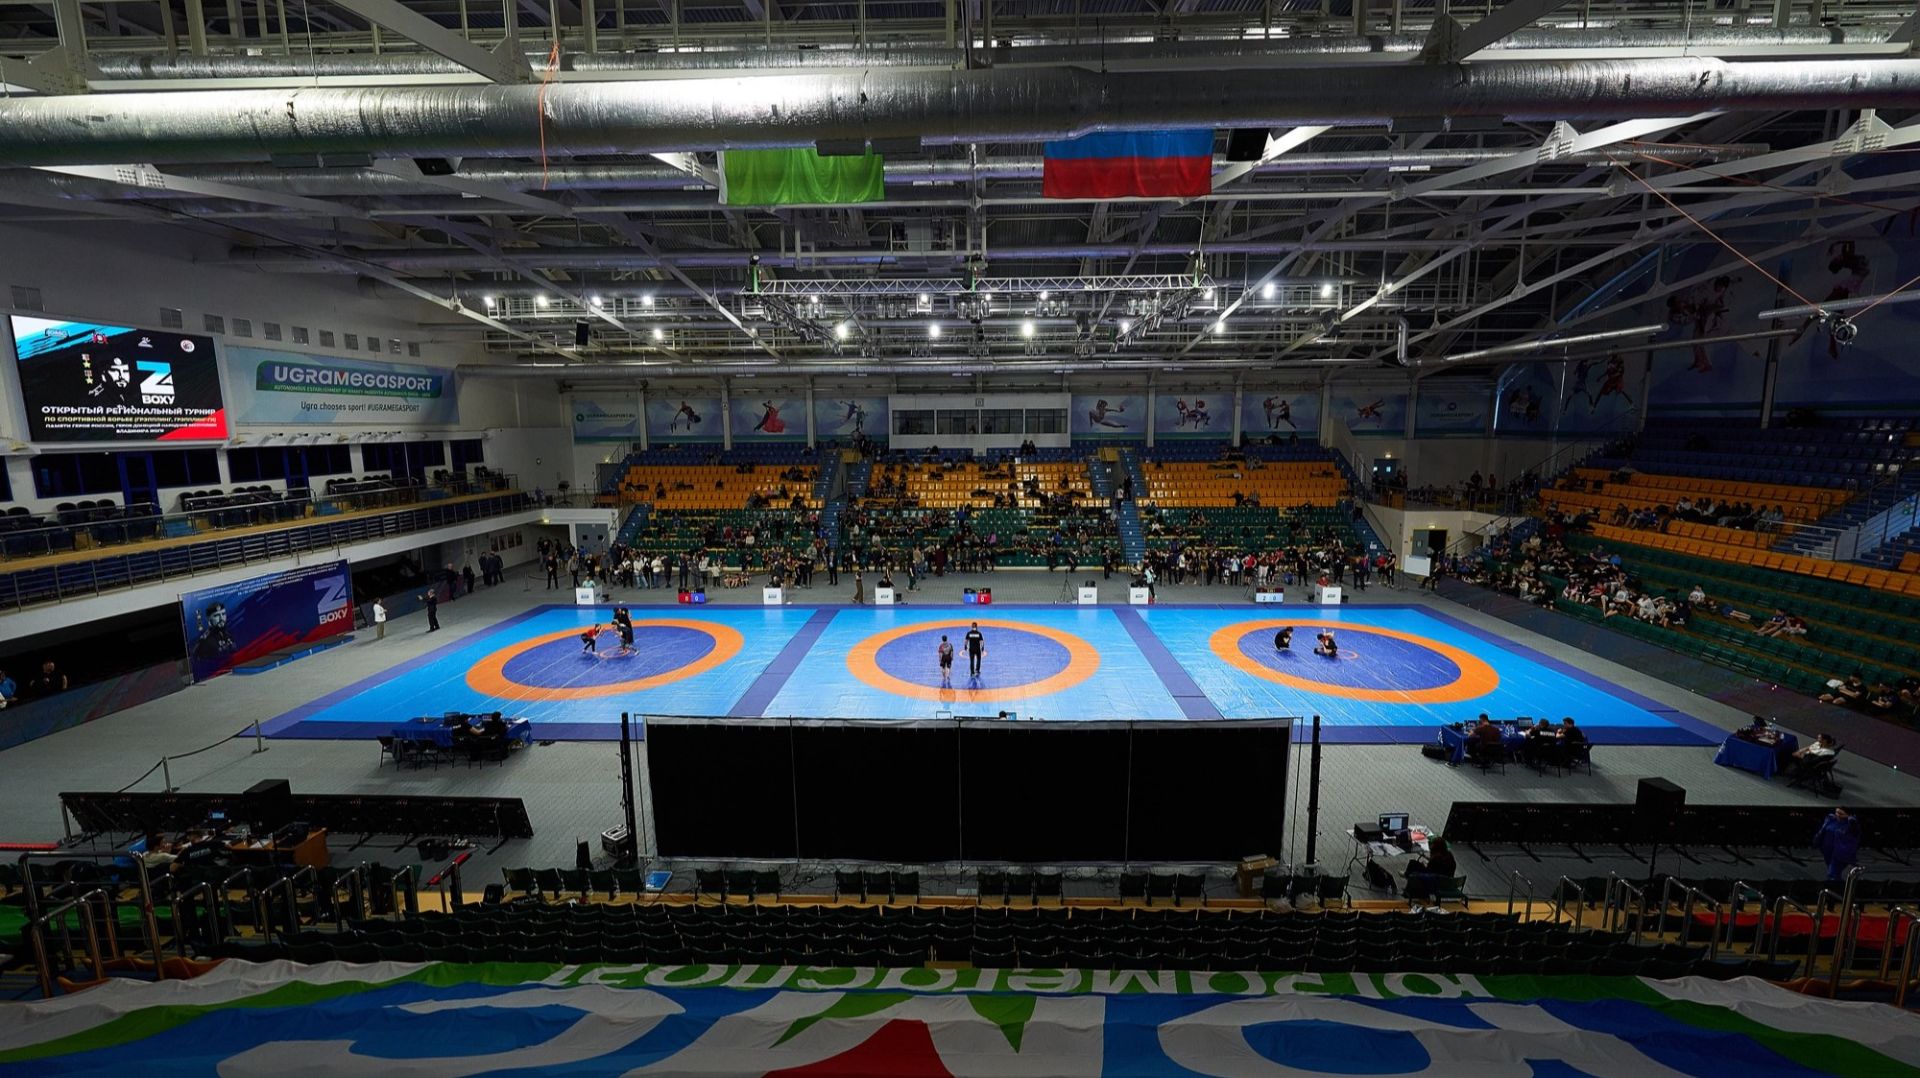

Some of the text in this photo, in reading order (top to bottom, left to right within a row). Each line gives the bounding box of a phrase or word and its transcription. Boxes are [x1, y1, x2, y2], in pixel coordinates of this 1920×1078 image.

[41, 406, 104, 415] ОТКРЫТЫЙ
[106, 406, 182, 415] РЕГИОНАЛЬНЫЙ
[301, 401, 317, 411] Ugra
[319, 402, 346, 411] chooses
[348, 403, 366, 412] sport!
